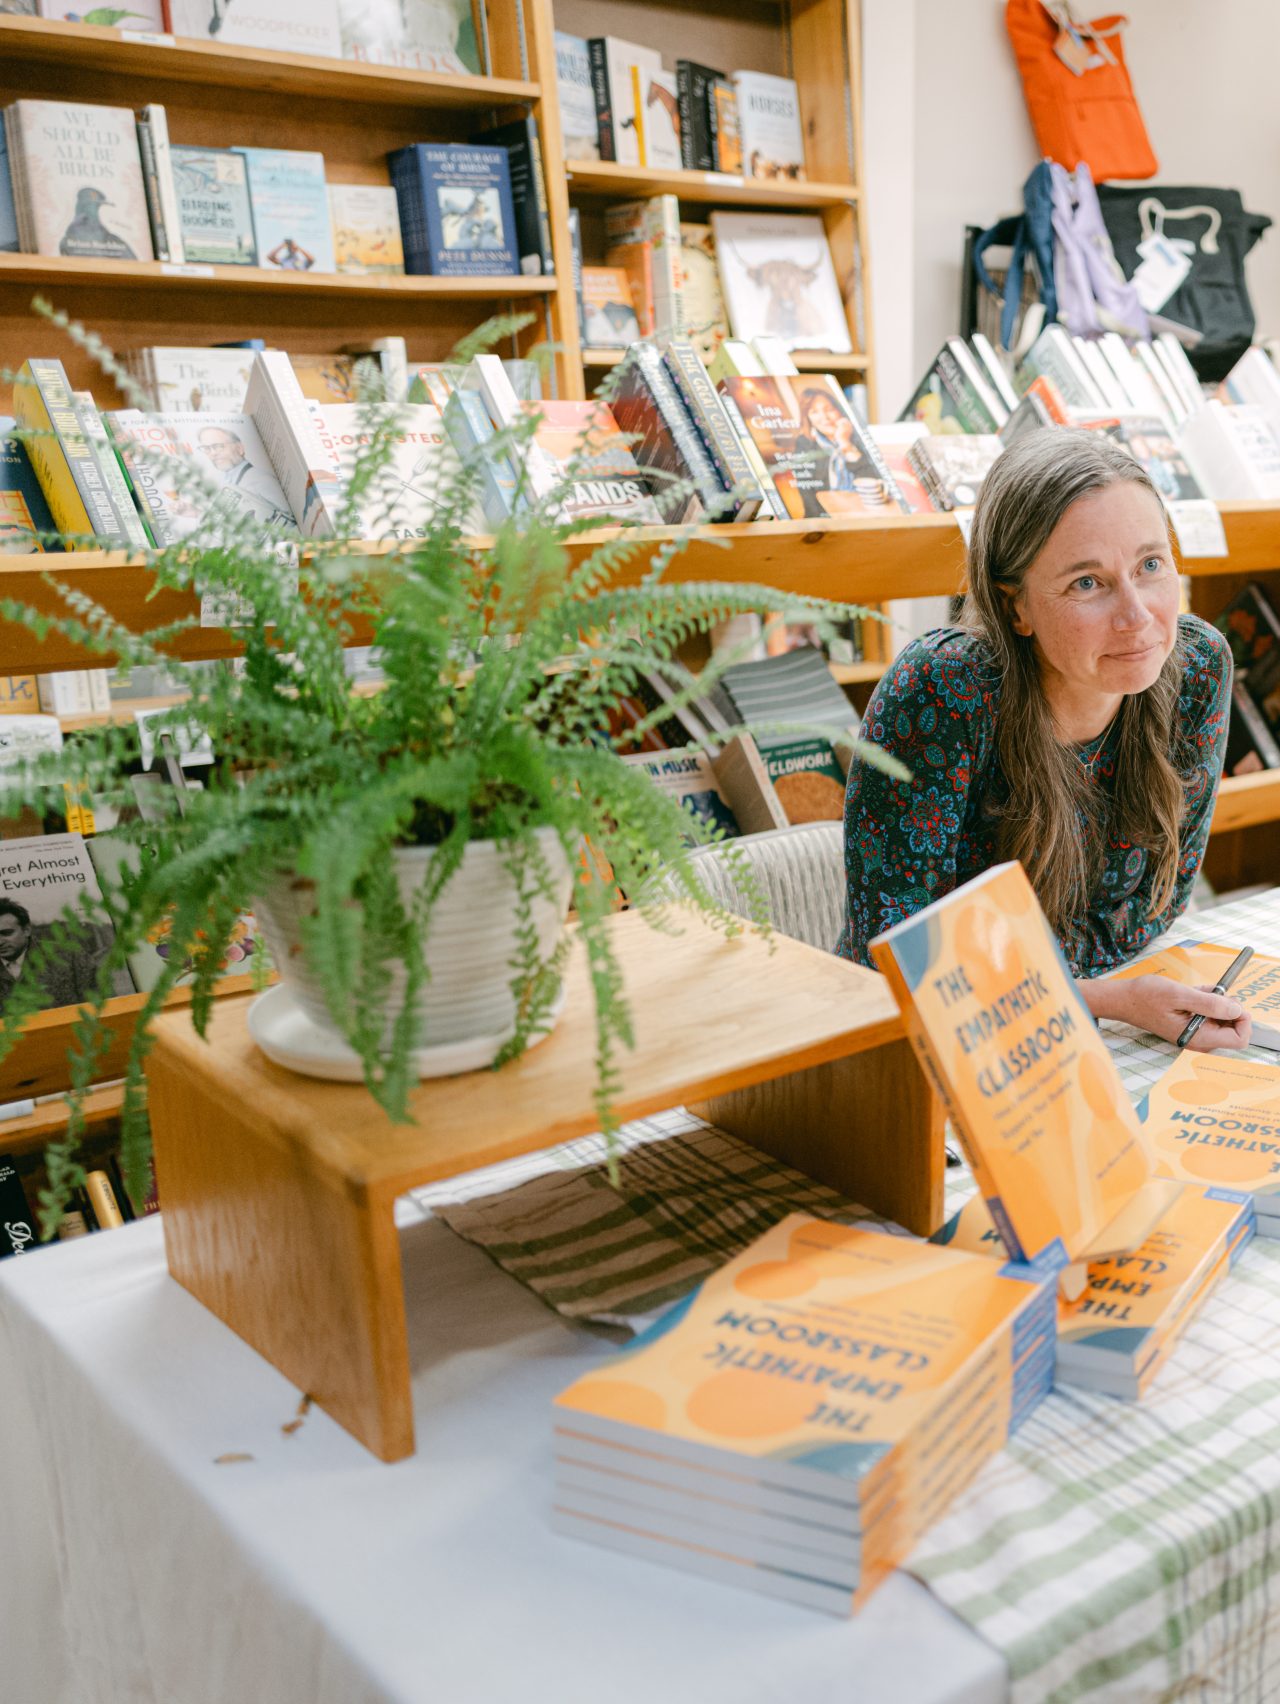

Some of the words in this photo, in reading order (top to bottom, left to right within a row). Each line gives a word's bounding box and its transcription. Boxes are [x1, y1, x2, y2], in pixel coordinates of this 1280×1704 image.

[230, 14, 330, 39] WOODPECKER
[351, 43, 460, 74] BIRDS
[63, 110, 96, 127] WE
[42, 127, 121, 146] SHOULD
[53, 144, 87, 160] ALL
[94, 147, 116, 162] BE
[58, 161, 116, 178] BIRDS
[173, 362, 208, 379] The
[202, 382, 241, 397] Birds
[756, 403, 782, 418] Ina
[750, 415, 801, 430] Garten
[28, 856, 80, 872] Almost
[3, 872, 87, 891] Everything
[934, 965, 974, 1009] THE
[977, 1006, 1077, 1098] CLASSROOM
[1075, 1297, 1132, 1320] THE
[714, 1310, 931, 1372] CLASSROOM
[805, 1402, 873, 1433] THE
